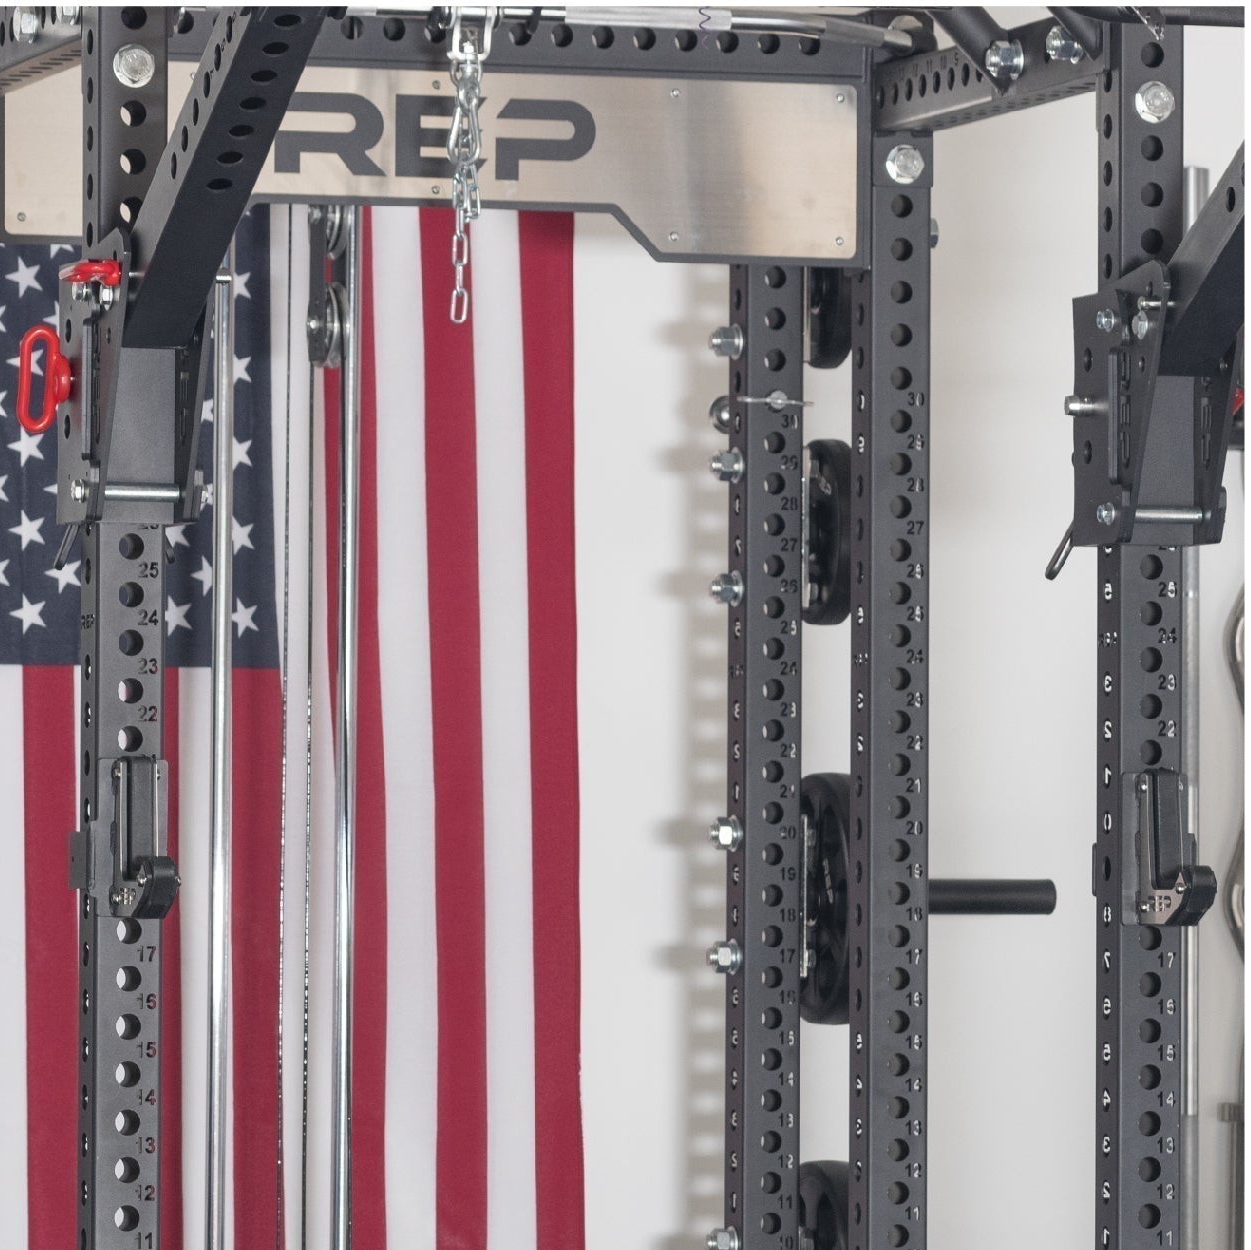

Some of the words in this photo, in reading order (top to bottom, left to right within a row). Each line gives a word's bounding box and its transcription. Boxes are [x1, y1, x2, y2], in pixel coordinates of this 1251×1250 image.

[274, 92, 596, 180] REP
[138, 561, 158, 578] 25
[1159, 581, 1177, 598] 25
[138, 609, 158, 626] 24
[1158, 628, 1177, 644] 24
[138, 657, 158, 674] 23
[1158, 674, 1177, 691] 23
[138, 705, 157, 722] 22
[1158, 720, 1176, 737] 22
[137, 945, 156, 962] 17
[1158, 952, 1176, 968] 17
[136, 1041, 156, 1058] 15
[1158, 1045, 1175, 1061] 15
[136, 1089, 155, 1106] 14
[1158, 1091, 1175, 1107] 14
[136, 1137, 155, 1154] 13
[1157, 1137, 1175, 1153] 13
[136, 1185, 155, 1201] 12
[1157, 1184, 1175, 1200] 12
[135, 1232, 155, 1249] 11
[1157, 1230, 1175, 1246] 11
